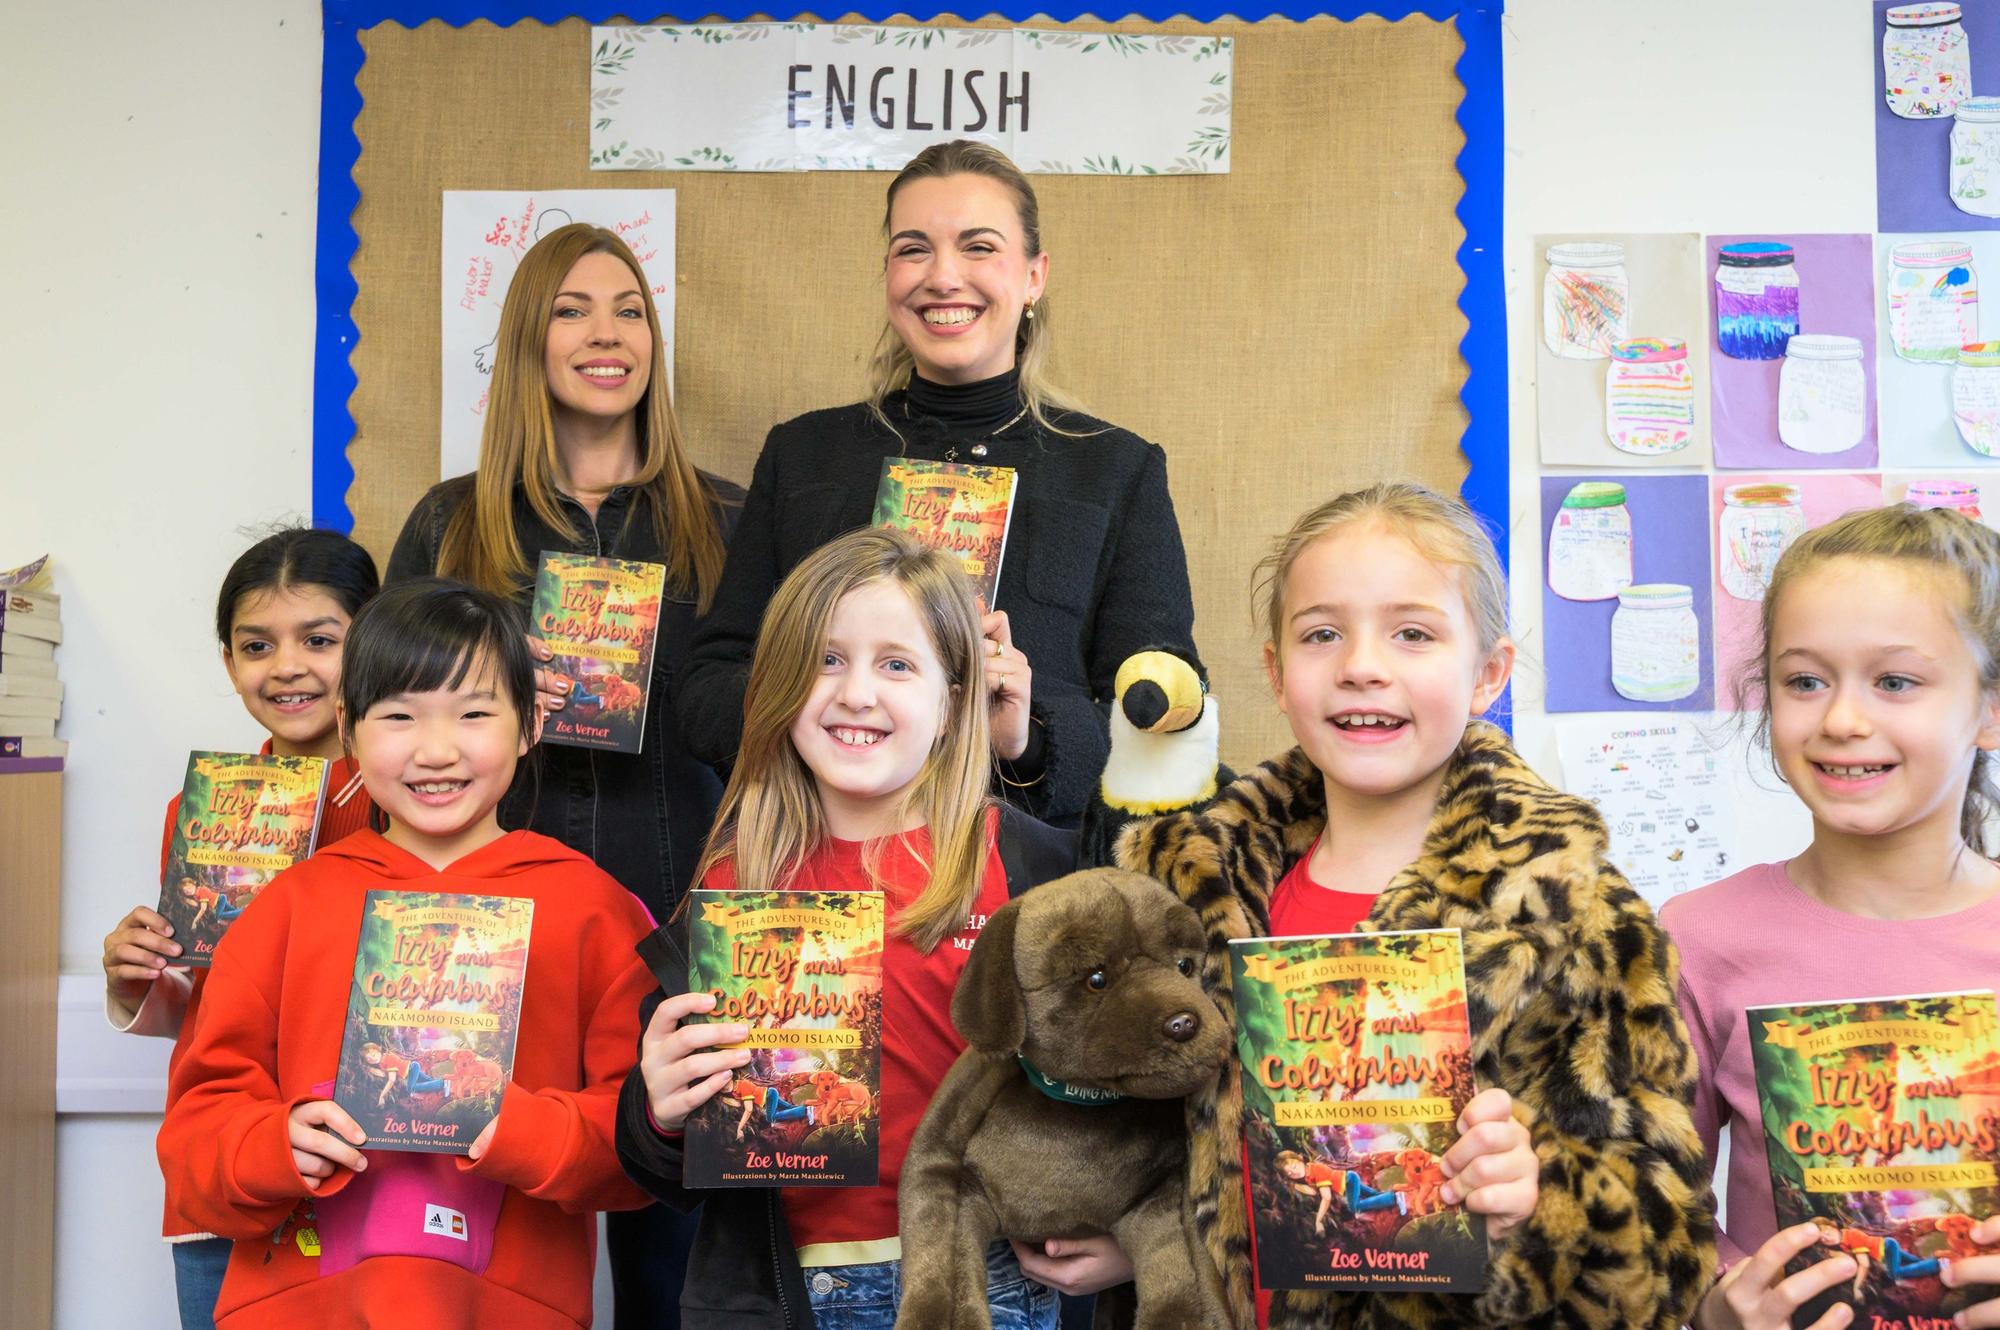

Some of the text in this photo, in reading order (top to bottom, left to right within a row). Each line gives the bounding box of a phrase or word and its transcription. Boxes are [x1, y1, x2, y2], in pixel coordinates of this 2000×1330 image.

[788, 64, 1029, 132] ENGLISH
[926, 478, 976, 490] ADVENTURES
[978, 485, 987, 493] OF
[901, 493, 982, 525] Izzy and
[560, 585, 635, 616] Izzy and
[541, 613, 647, 646] Columbus
[549, 642, 636, 661] NAKAMOMO ISLAND
[556, 720, 610, 738] Zoe Verner
[1611, 727, 1677, 739] COPING SKILLS
[217, 770, 232, 778] THE
[234, 769, 284, 782] ADVENTURES
[208, 787, 290, 818] Izzy and
[185, 818, 302, 850] Columbus
[190, 852, 289, 867] NAKAMOMO ISLAND
[400, 912, 497, 929] THE ADVENTURES OF
[736, 913, 848, 929] THE ADVENTURES OF
[194, 939, 213, 953] Zoe
[392, 933, 493, 970] Izzy and
[731, 940, 847, 983] Izzy and
[1284, 964, 1418, 985] THE ADVENTURES OF
[365, 972, 508, 1008] Columbus
[373, 1011, 494, 1028] NAKAMOMO ISLAND
[1283, 998, 1424, 1046] Izzy and
[743, 1033, 855, 1044] AMOMO ISLAND
[1808, 1028, 1951, 1049] THE ADVENTURES OF
[1260, 1045, 1455, 1090] Columbus
[1808, 1064, 1962, 1111] Izzy and
[1281, 1104, 1444, 1120] NAKAMOMO ISLAND
[384, 1118, 459, 1137] Zoe Verner
[1787, 1109, 1998, 1155] Columbus
[368, 1136, 401, 1144] ustrations
[402, 1138, 410, 1146] by
[746, 1152, 828, 1169] Zoe Verner
[768, 1173, 777, 1181] by
[1811, 1168, 1987, 1185] NAKAMOMO ISLAND
[1330, 1248, 1430, 1270] Zoe Verner
[1304, 1274, 1451, 1284] Illustrations by Marta Maszkiewicz
